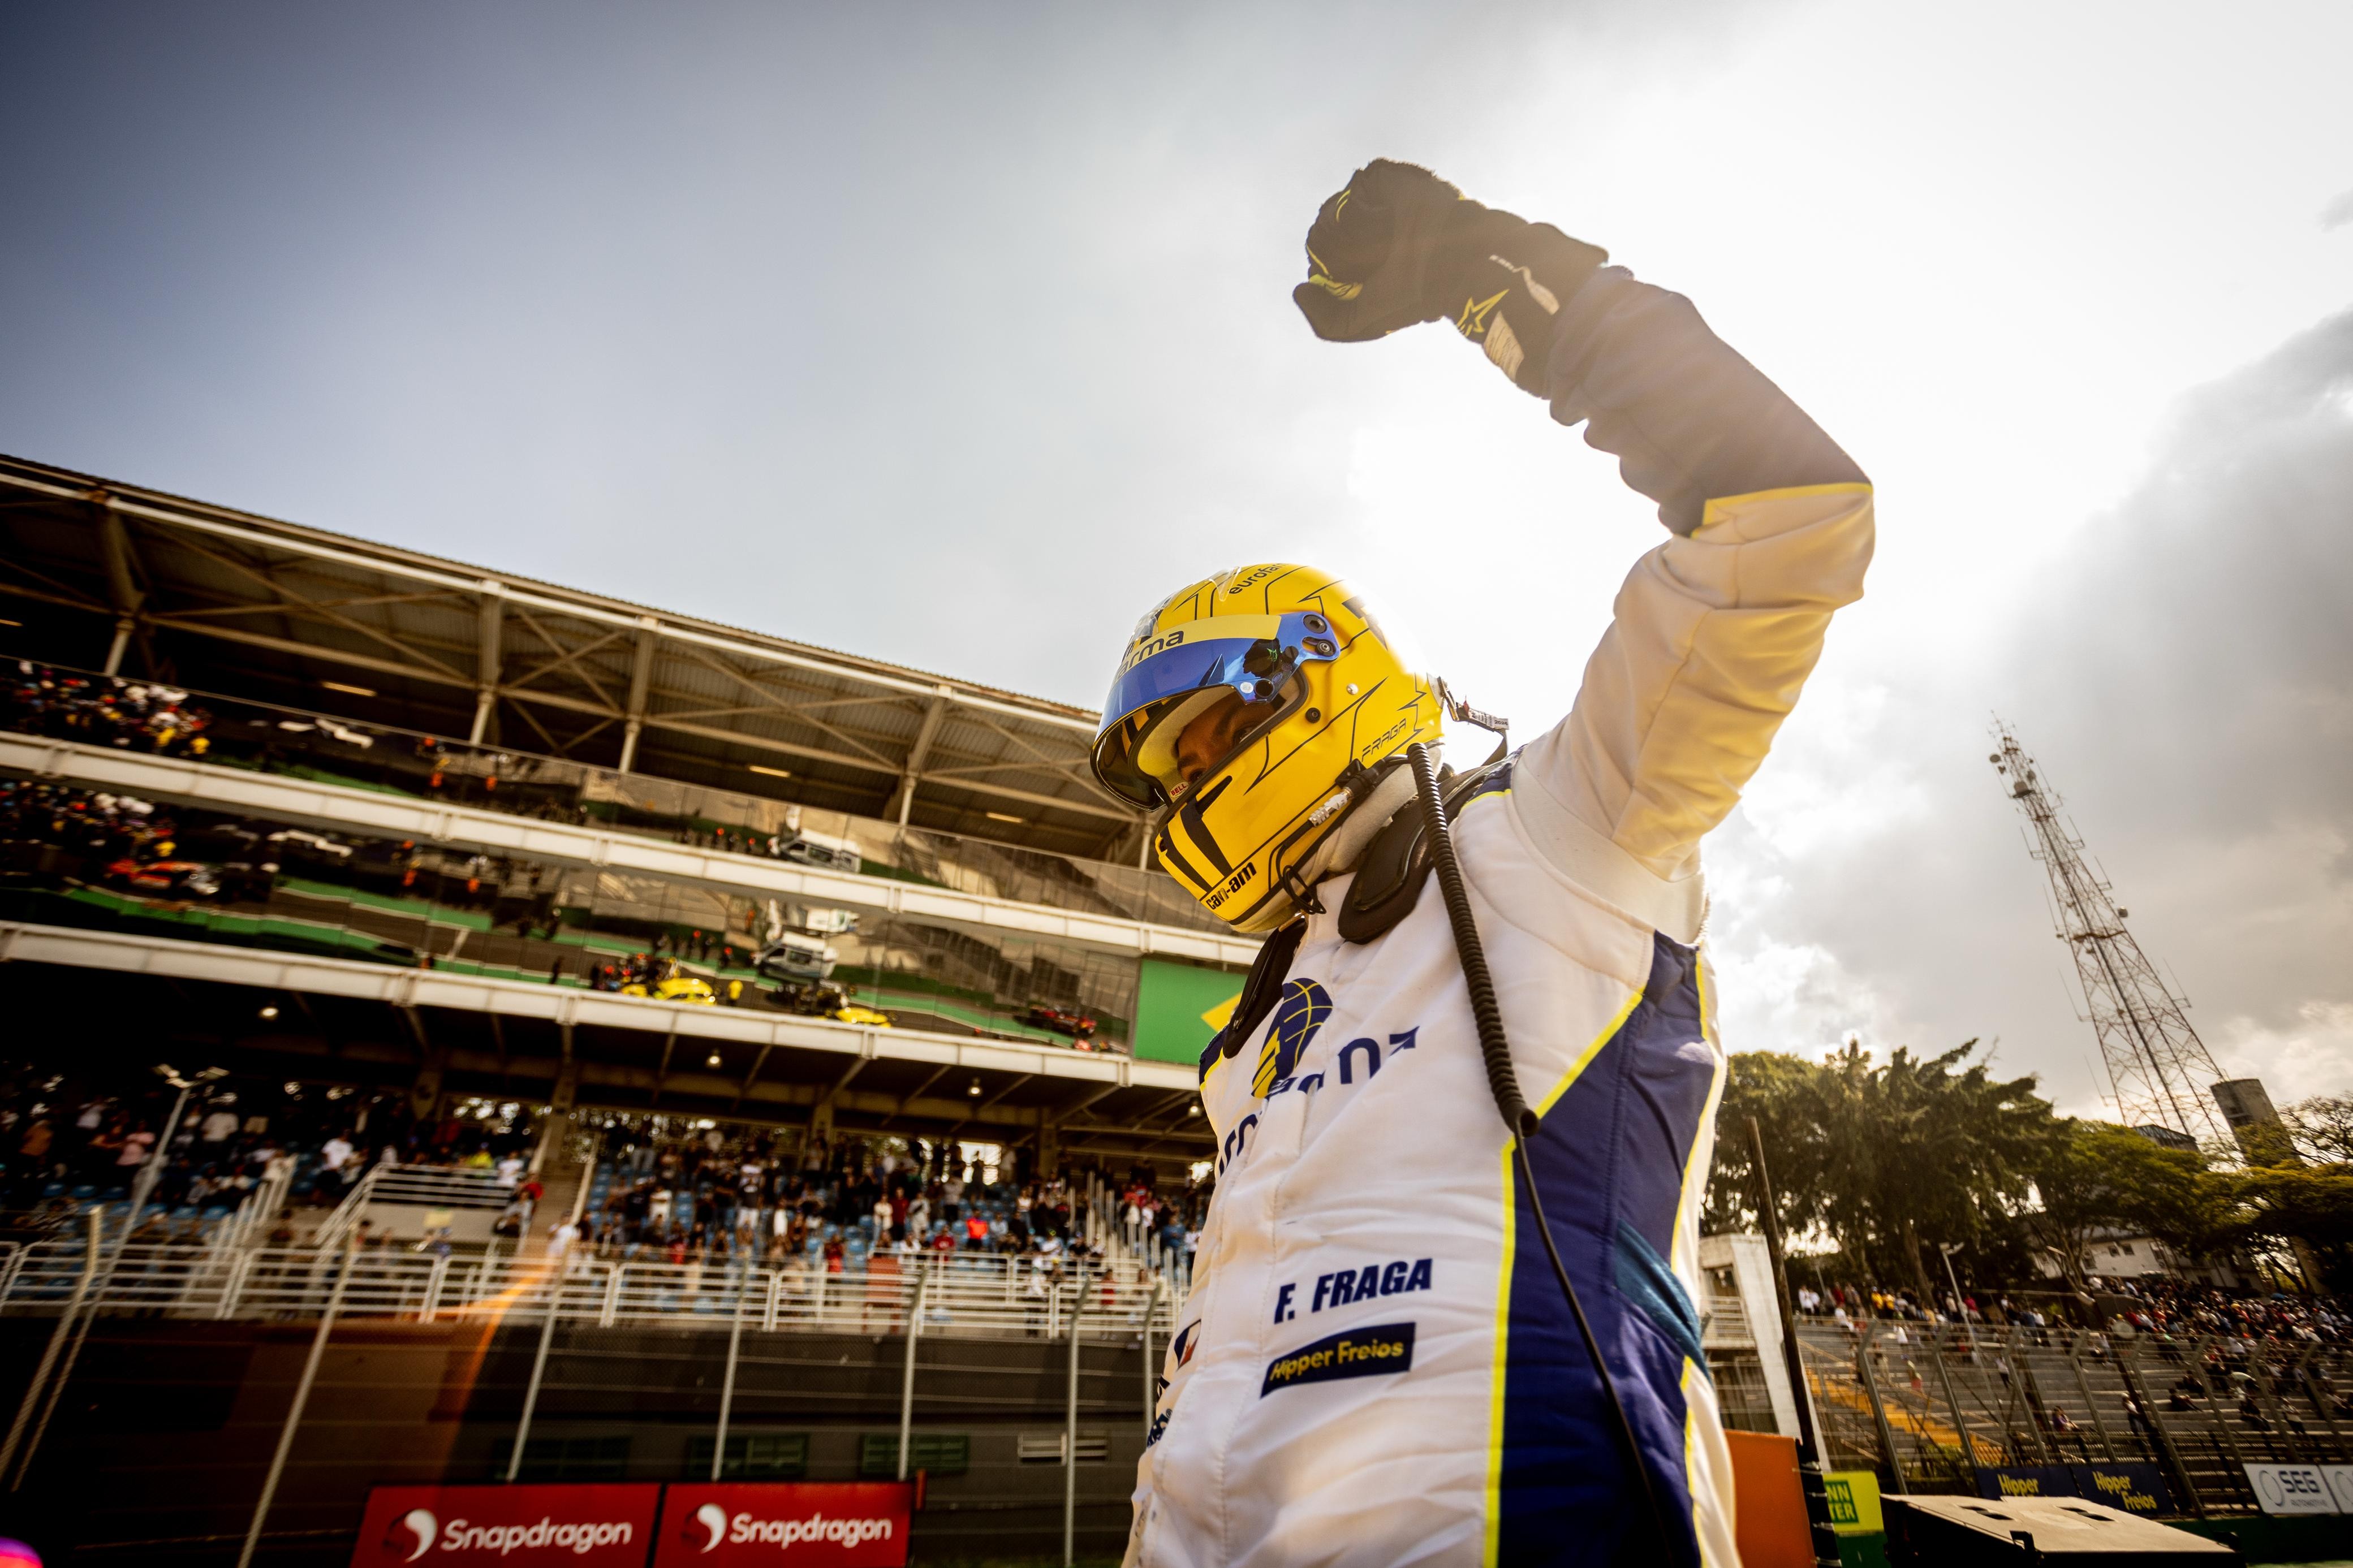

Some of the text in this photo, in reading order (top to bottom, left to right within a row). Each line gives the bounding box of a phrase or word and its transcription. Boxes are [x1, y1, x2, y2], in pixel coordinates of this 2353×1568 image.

[1117, 630, 1184, 680] arma
[1361, 718, 1407, 762] FRAGA
[1171, 784, 1187, 796] BELL
[1205, 862, 1257, 910] can-am
[1274, 1258, 1433, 1325] F. FRAGA
[1269, 1339, 1404, 1381] Hipper Freios
[1825, 1484, 1851, 1502] NN
[1997, 1474, 2039, 1497] Hipper
[2092, 1471, 2132, 1494] Hipper
[2121, 1491, 2158, 1510] Freios
[729, 1511, 893, 1550] Snapdragon
[1828, 1502, 1856, 1521] TER
[440, 1516, 633, 1557] Snapdragon
